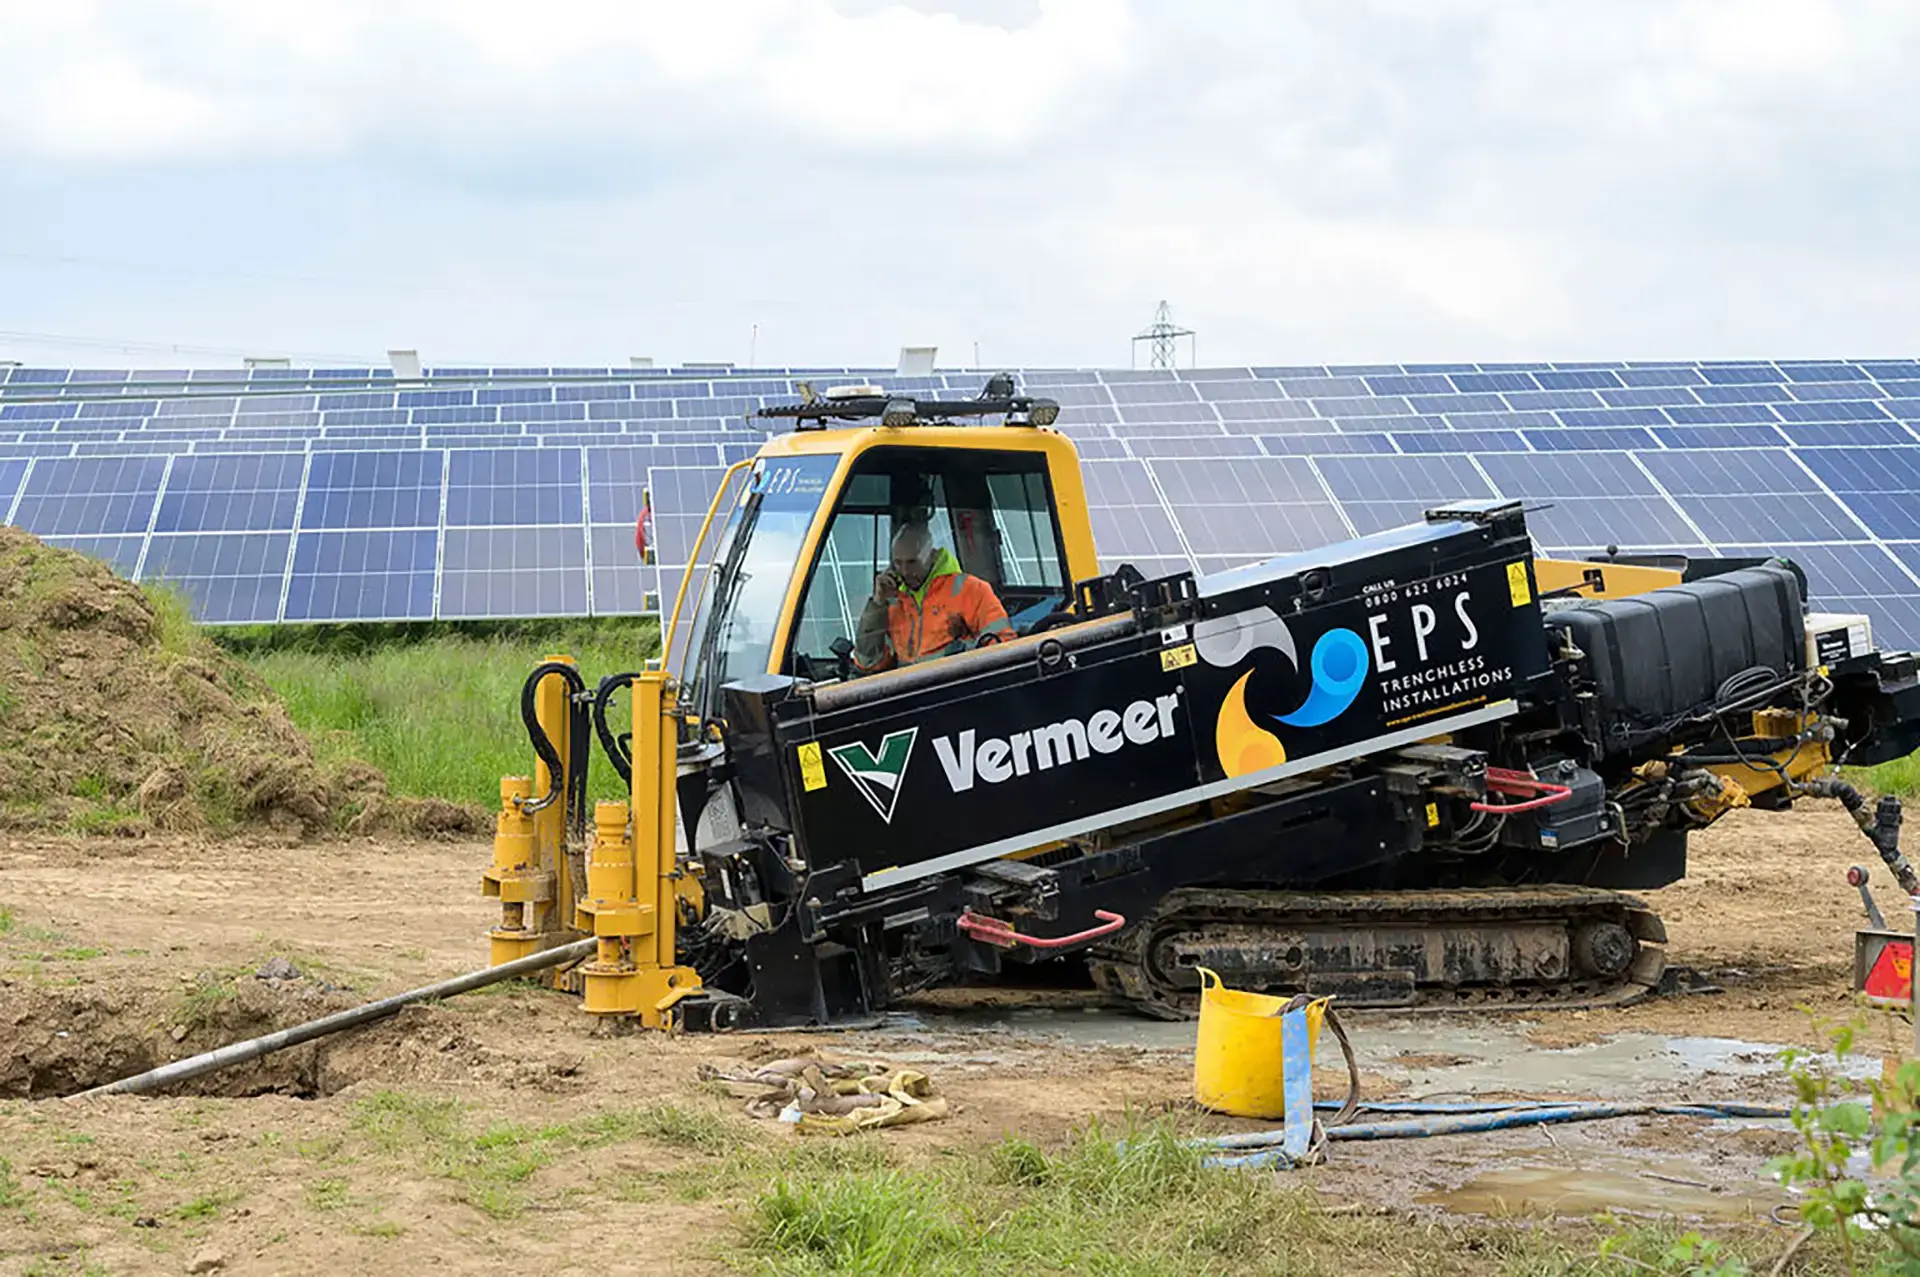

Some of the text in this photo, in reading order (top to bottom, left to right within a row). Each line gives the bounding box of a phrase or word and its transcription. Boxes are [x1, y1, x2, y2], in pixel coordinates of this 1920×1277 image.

[768, 468, 801, 494] EPS
[1365, 573, 1467, 608] 0800 622 6024
[1368, 591, 1478, 673] EPS
[1380, 655, 1485, 694] TRENCHLESS
[1383, 666, 1512, 713] INSTALLATIONS
[931, 692, 1179, 793] Vermeer
